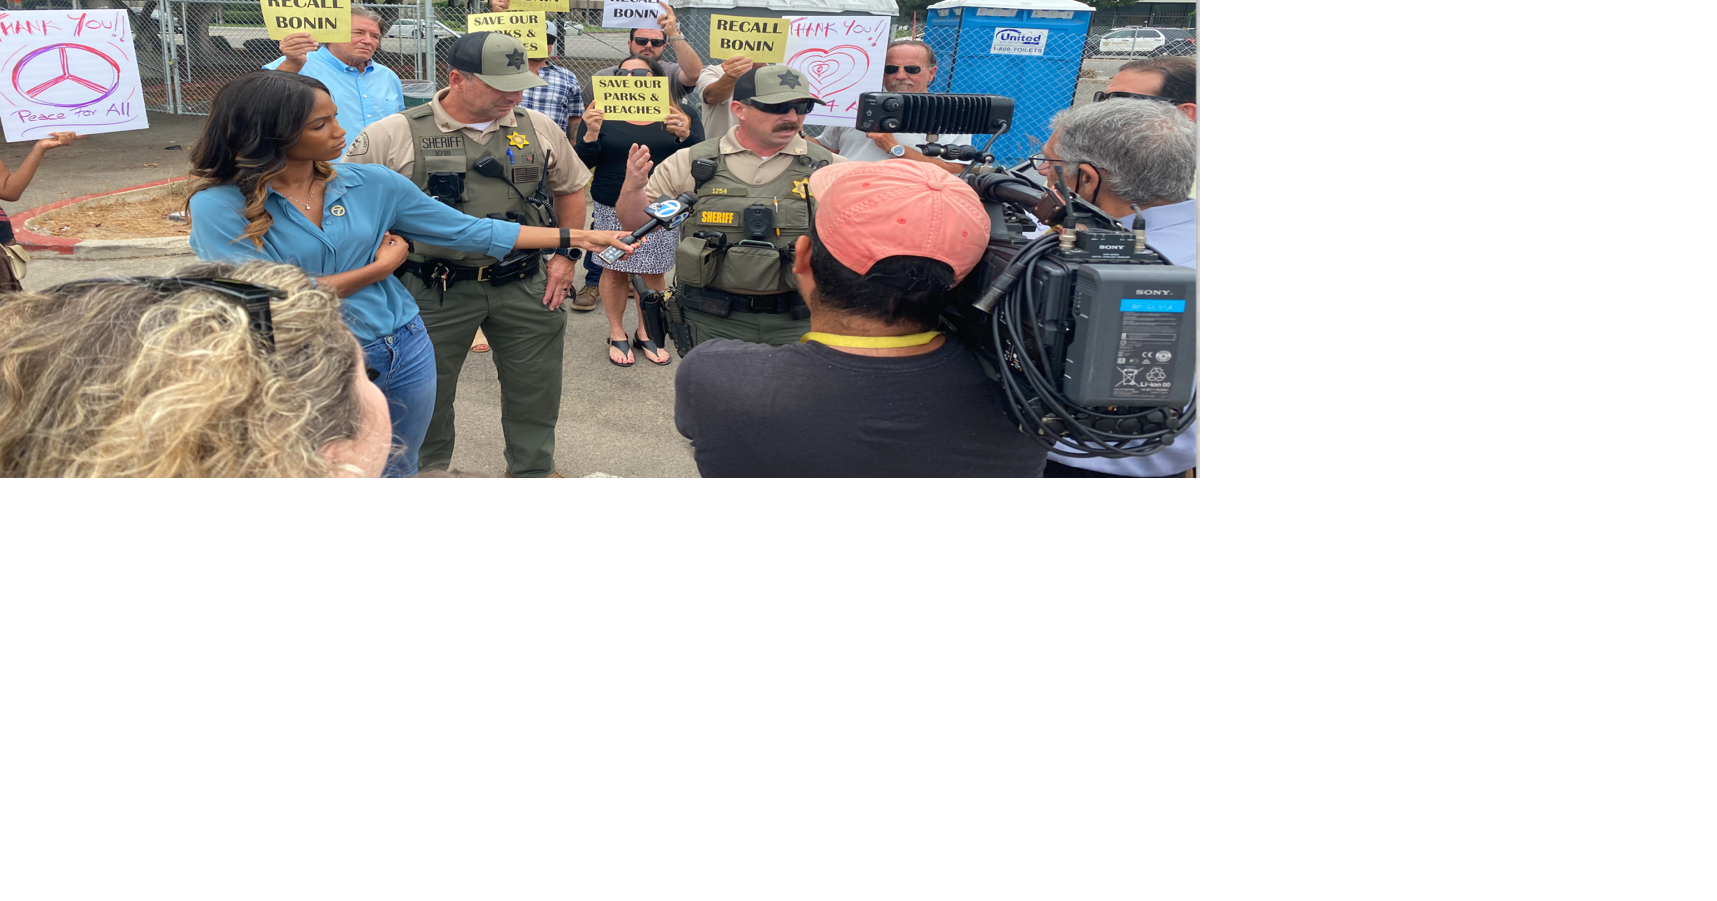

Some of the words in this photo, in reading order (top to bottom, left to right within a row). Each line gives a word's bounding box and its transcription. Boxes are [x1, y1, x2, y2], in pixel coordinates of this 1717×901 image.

[613, 8, 659, 19] BONIN
[275, 16, 337, 29] BONIN
[474, 16, 506, 26] SAVE
[509, 15, 539, 25] OUR
[717, 19, 783, 34] RECALL
[790, 17, 838, 37] THANK
[526, 29, 537, 38] &
[1001, 33, 1041, 41] United
[720, 38, 774, 52] BONIN
[599, 79, 631, 89] SAVE
[634, 79, 662, 89] OUR
[604, 92, 646, 102] PARKS
[650, 93, 660, 102] &
[11, 109, 66, 123] Peace
[106, 101, 130, 117] All
[604, 105, 662, 115] BEACHES
[422, 136, 462, 149] SHERIFF
[701, 211, 734, 224] SHERIFF
